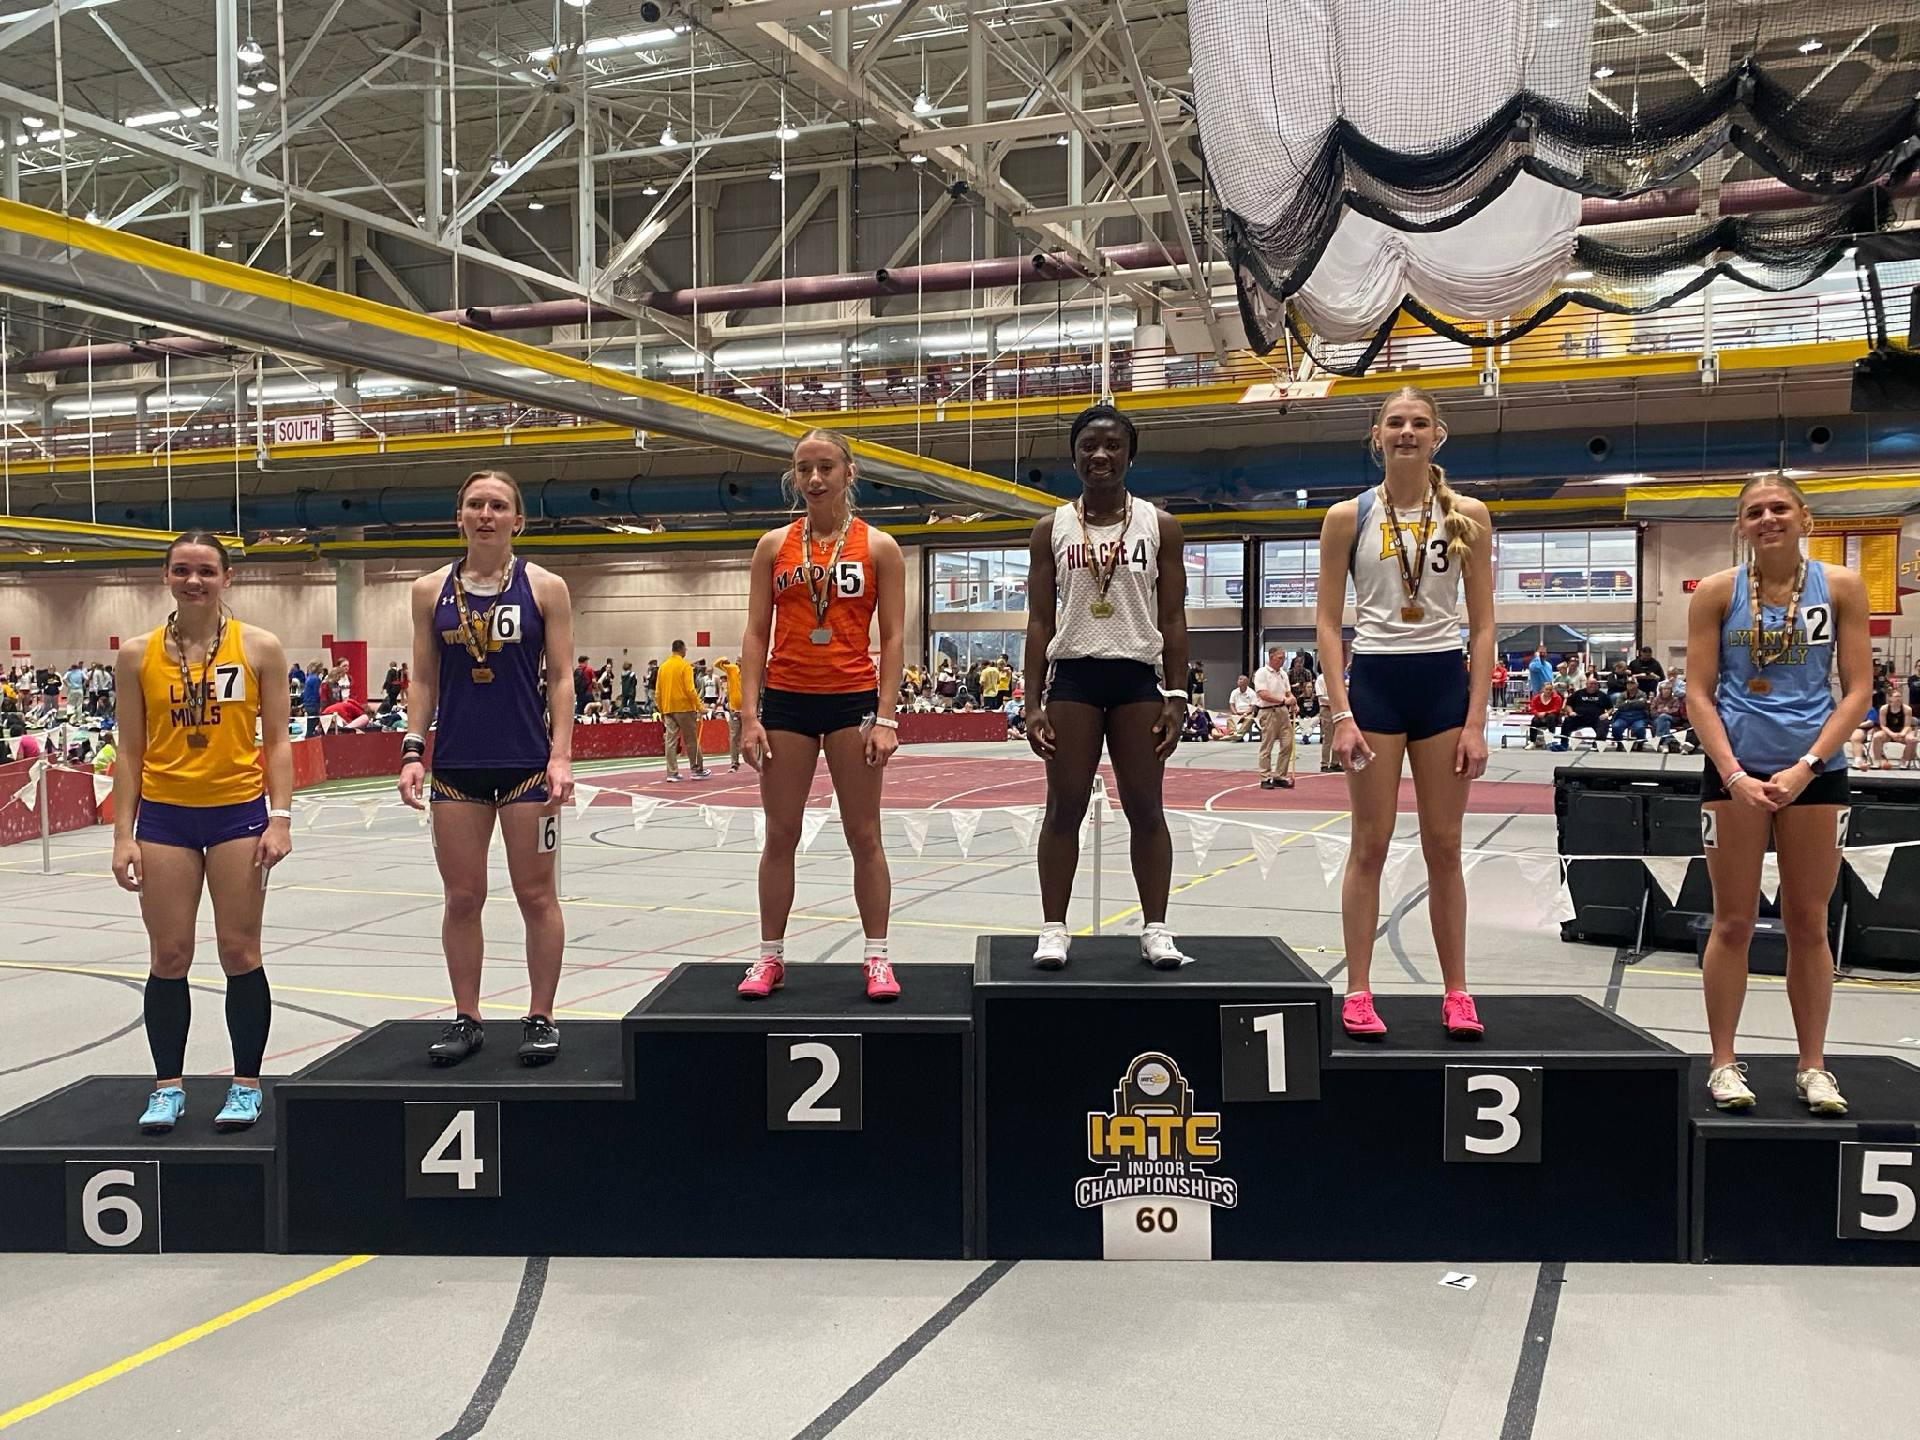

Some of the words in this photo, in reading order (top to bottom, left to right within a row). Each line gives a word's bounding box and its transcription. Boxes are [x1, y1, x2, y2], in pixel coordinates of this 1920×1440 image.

[279, 420, 318, 441] SOUTH
[1132, 538, 1148, 571] 4
[1431, 540, 1450, 573] 3
[841, 563, 861, 595] 5
[497, 606, 515, 638] 6
[1806, 606, 1829, 641] 2
[216, 667, 239, 699] 7
[544, 816, 556, 850] 6
[1701, 811, 1715, 847] 2
[1253, 1012, 1287, 1093] 1
[787, 1042, 841, 1122] 2
[1465, 1074, 1521, 1154] 3
[421, 1110, 484, 1190] 4
[1091, 1116, 1217, 1156] IATC
[1128, 1161, 1185, 1176] INDOOR
[82, 1169, 143, 1247] 6
[1079, 1177, 1234, 1205] CHAMPIONSHIPS
[1860, 1150, 1917, 1232] 5
[1136, 1206, 1178, 1233] 60
